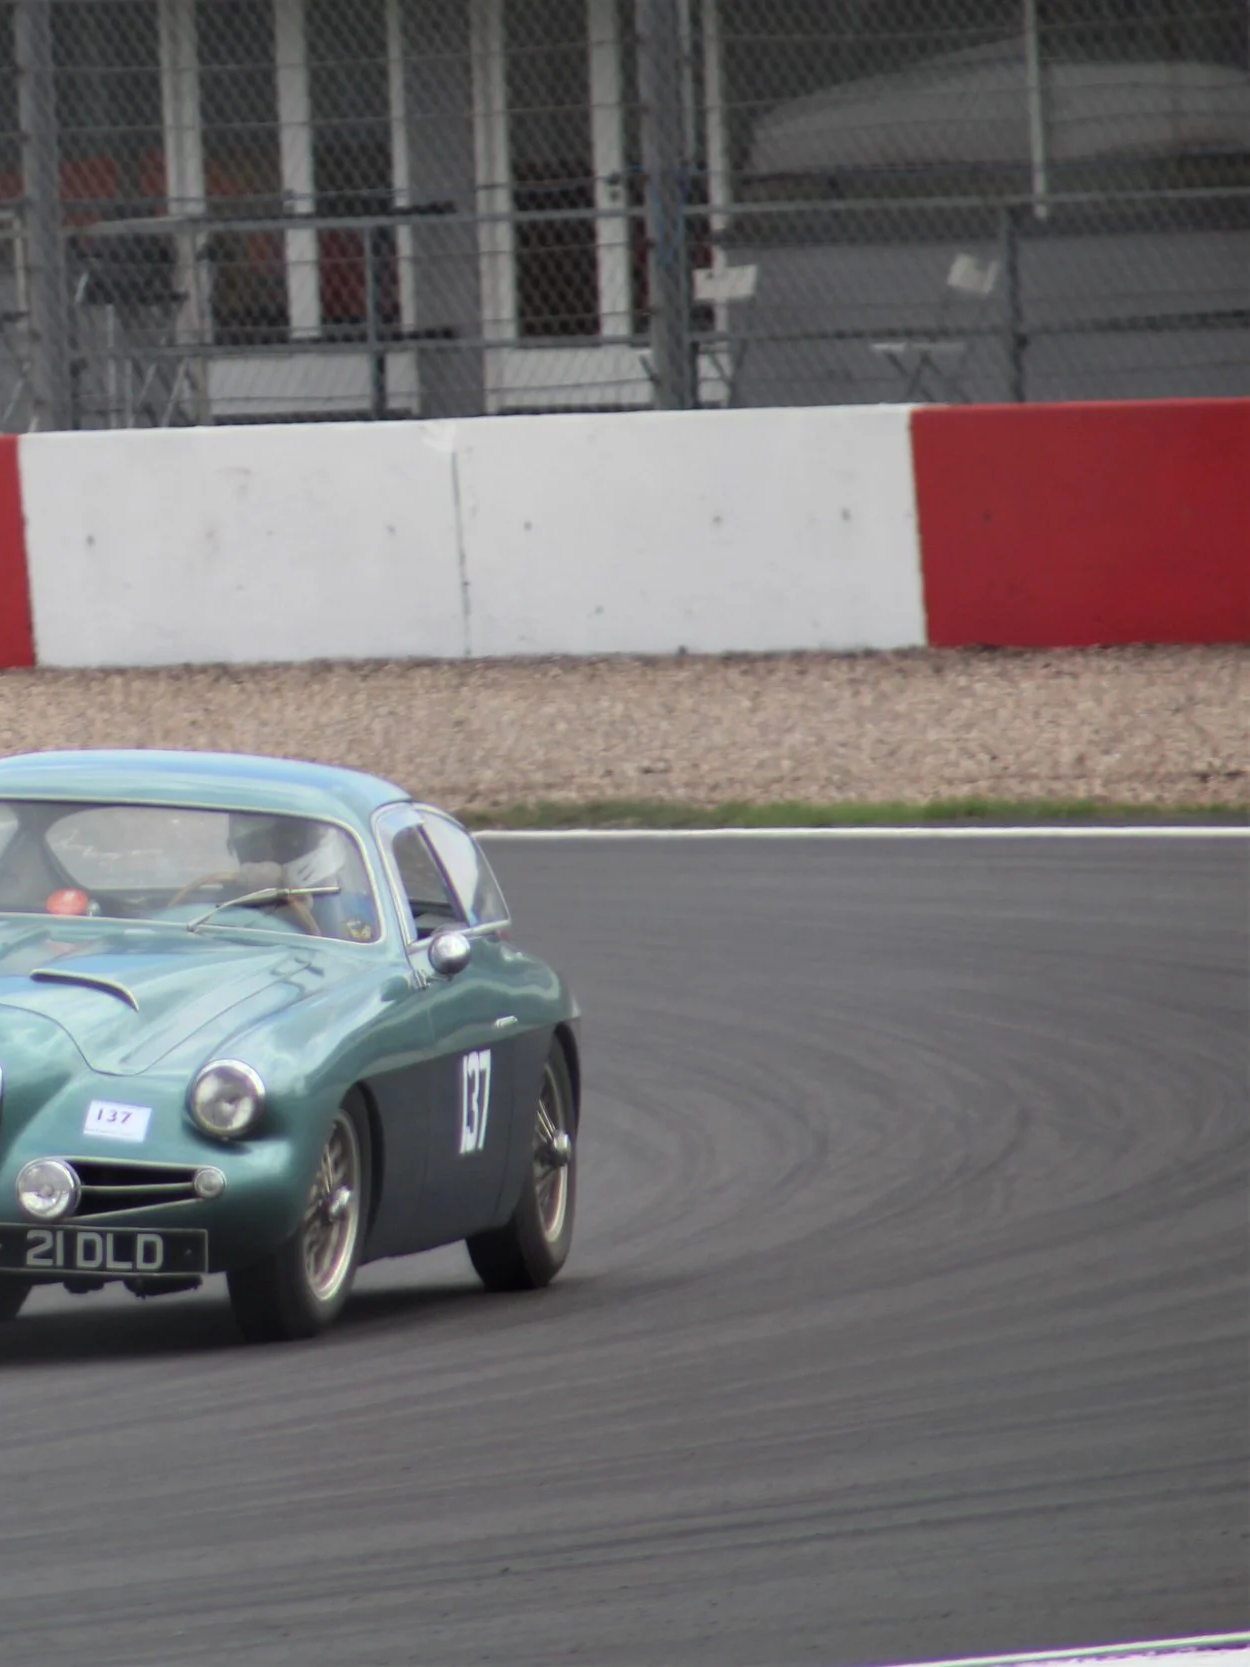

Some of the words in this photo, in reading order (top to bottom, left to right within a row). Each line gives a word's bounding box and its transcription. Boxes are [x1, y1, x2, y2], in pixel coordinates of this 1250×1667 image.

[96, 1107, 133, 1124] 137
[459, 1048, 491, 1154] 137
[26, 1229, 64, 1267] 21
[76, 1231, 164, 1270] DLD
